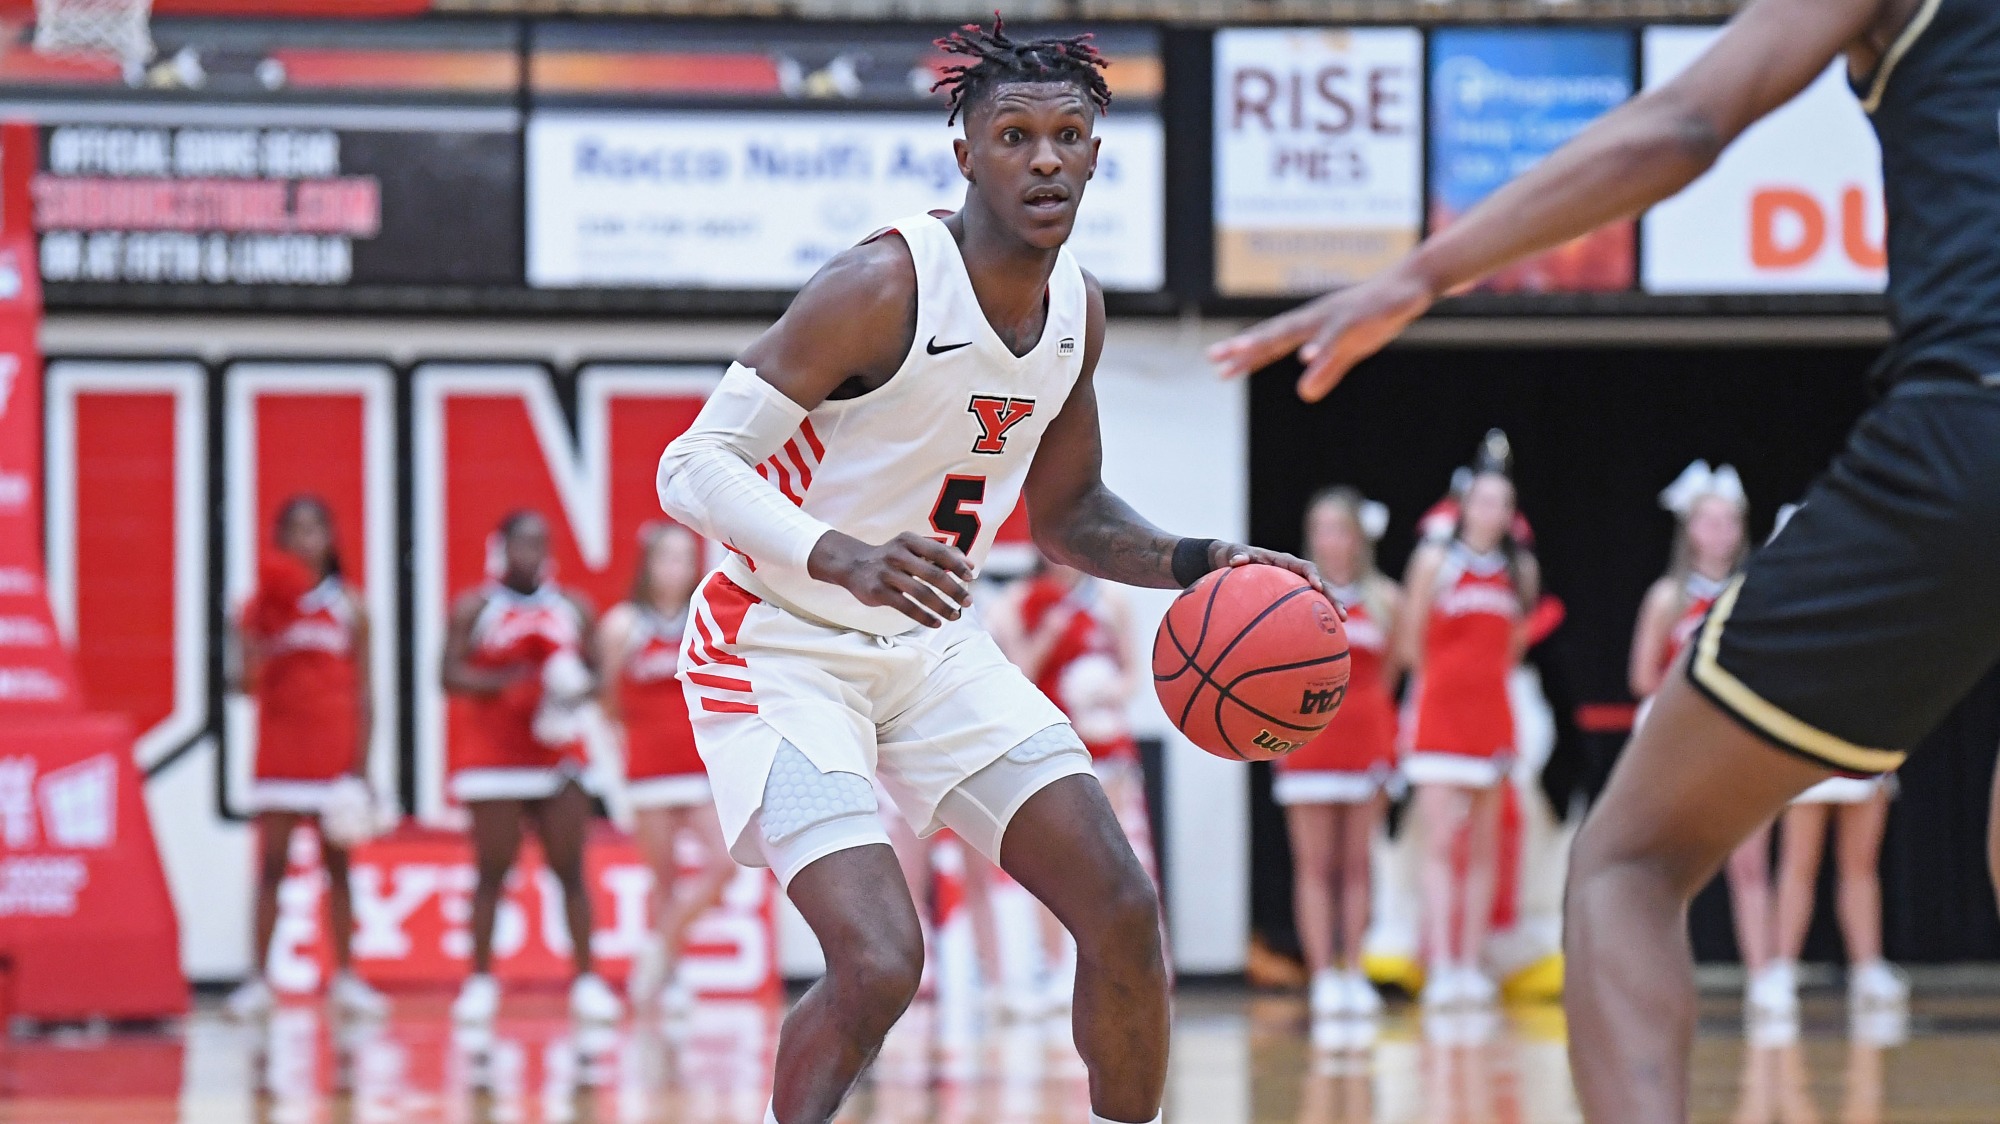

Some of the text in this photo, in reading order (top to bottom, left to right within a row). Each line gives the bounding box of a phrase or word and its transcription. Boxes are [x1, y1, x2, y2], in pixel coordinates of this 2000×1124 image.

[1230, 66, 1407, 135] RISE
[576, 141, 729, 182] Rocco
[968, 395, 1036, 454] Y
[928, 474, 986, 557] 5
[1301, 684, 1348, 714] CAA
